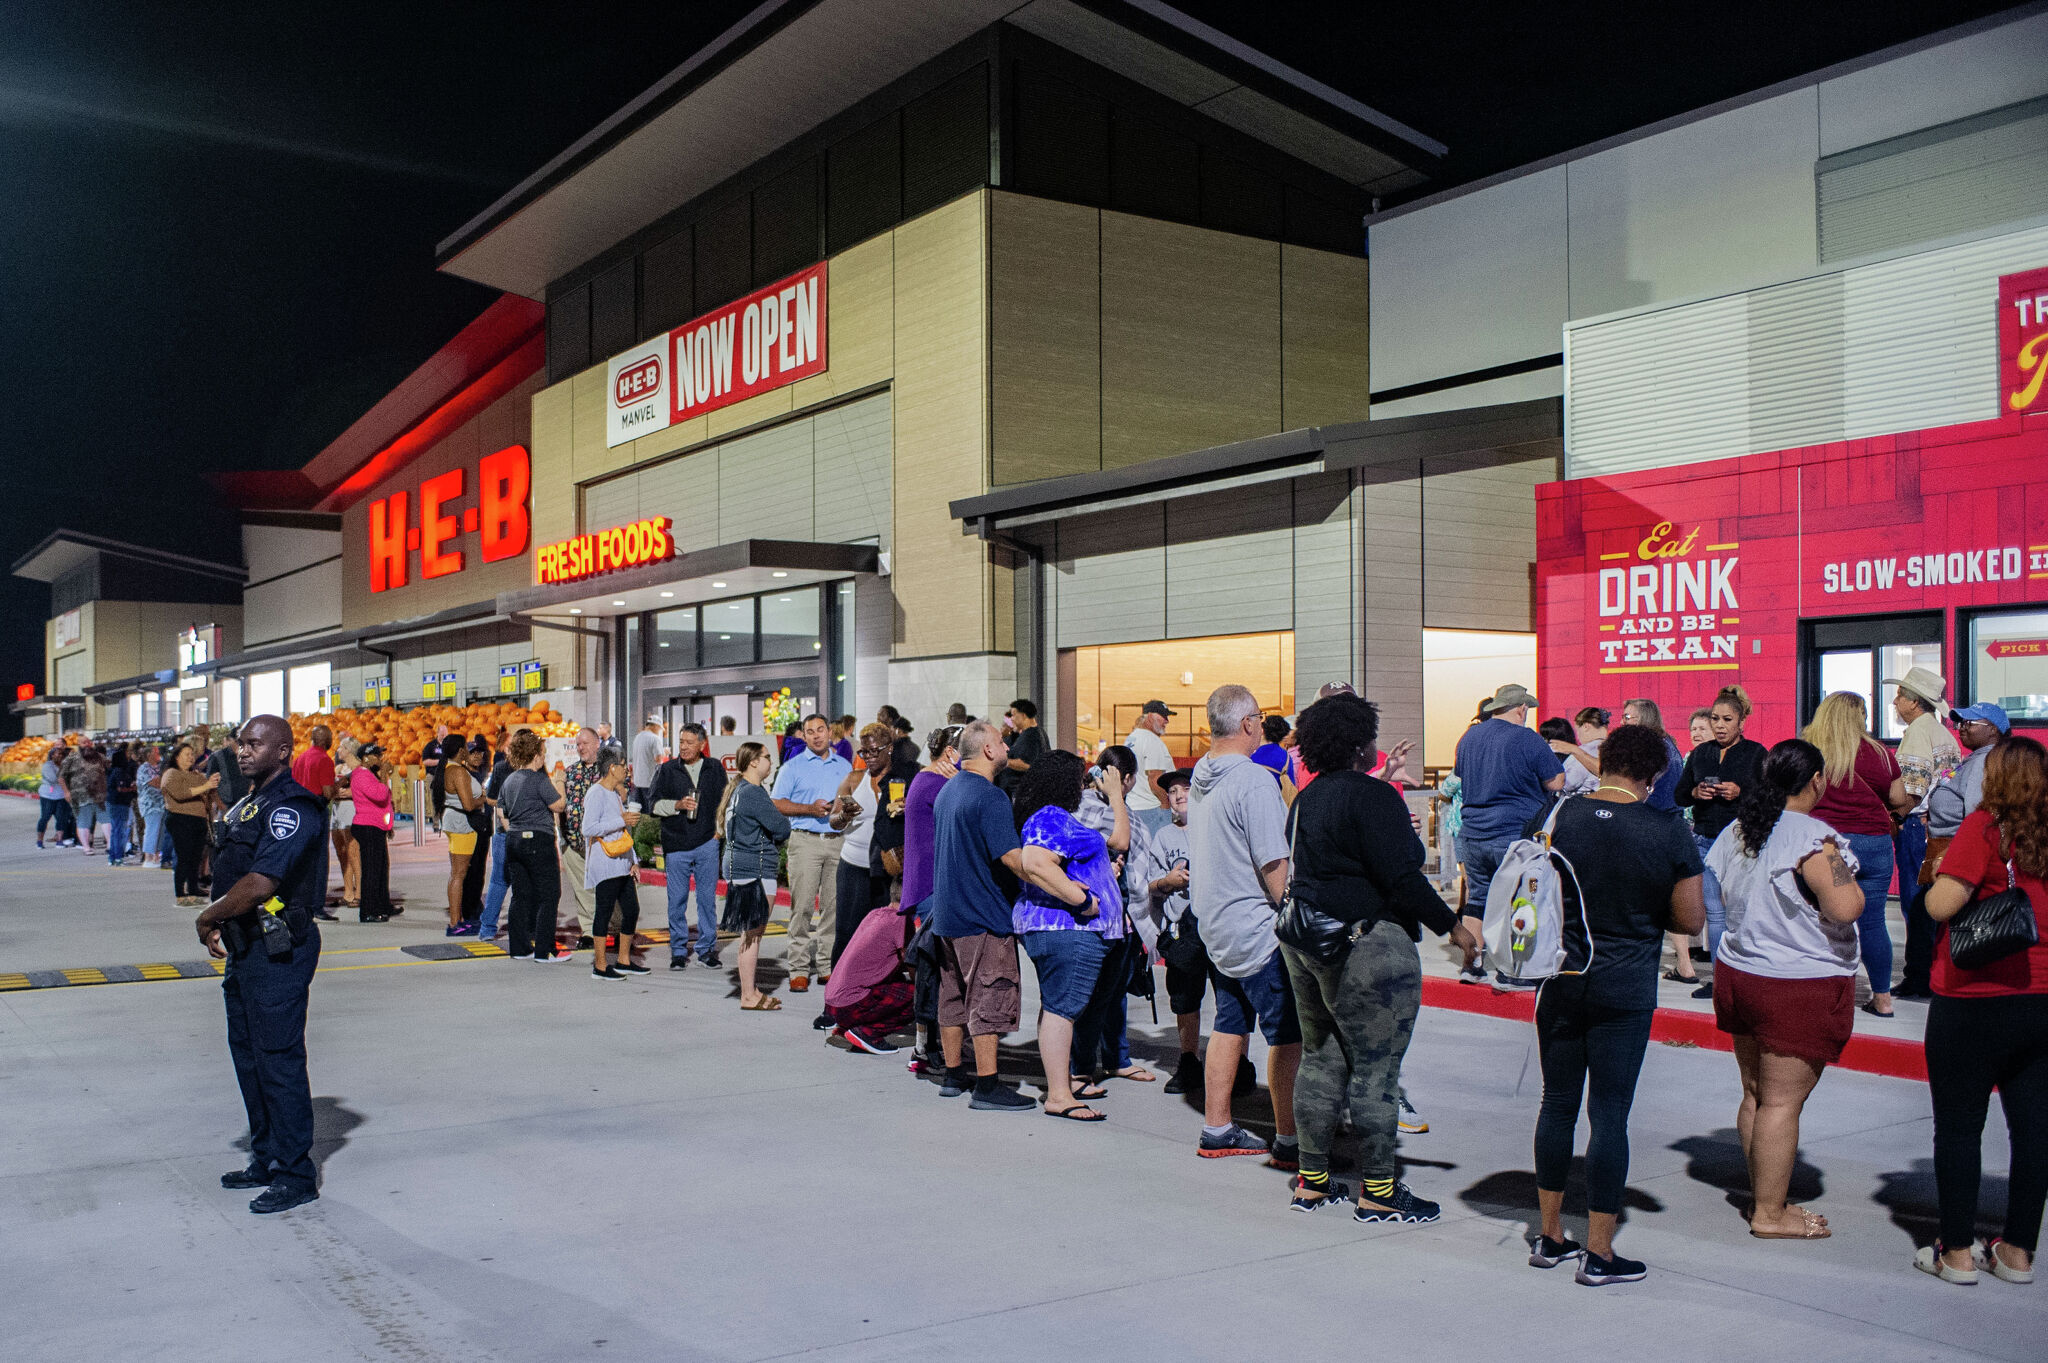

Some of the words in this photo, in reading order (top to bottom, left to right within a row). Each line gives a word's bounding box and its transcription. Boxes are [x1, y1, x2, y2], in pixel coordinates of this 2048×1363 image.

[677, 312, 736, 411] NOW
[742, 276, 818, 386] OPEN
[621, 404, 656, 430] MANVEL
[537, 534, 594, 585] FRESH
[599, 516, 668, 570] FOODS
[1638, 521, 1700, 561] Eat
[1599, 557, 1739, 617] DRINK
[1824, 547, 2022, 593] SLOW-SMOKED
[1619, 616, 1673, 635] AND
[1681, 614, 1715, 631] BE
[1600, 634, 1739, 663] TEXAN
[2000, 644, 2040, 654] PICK
